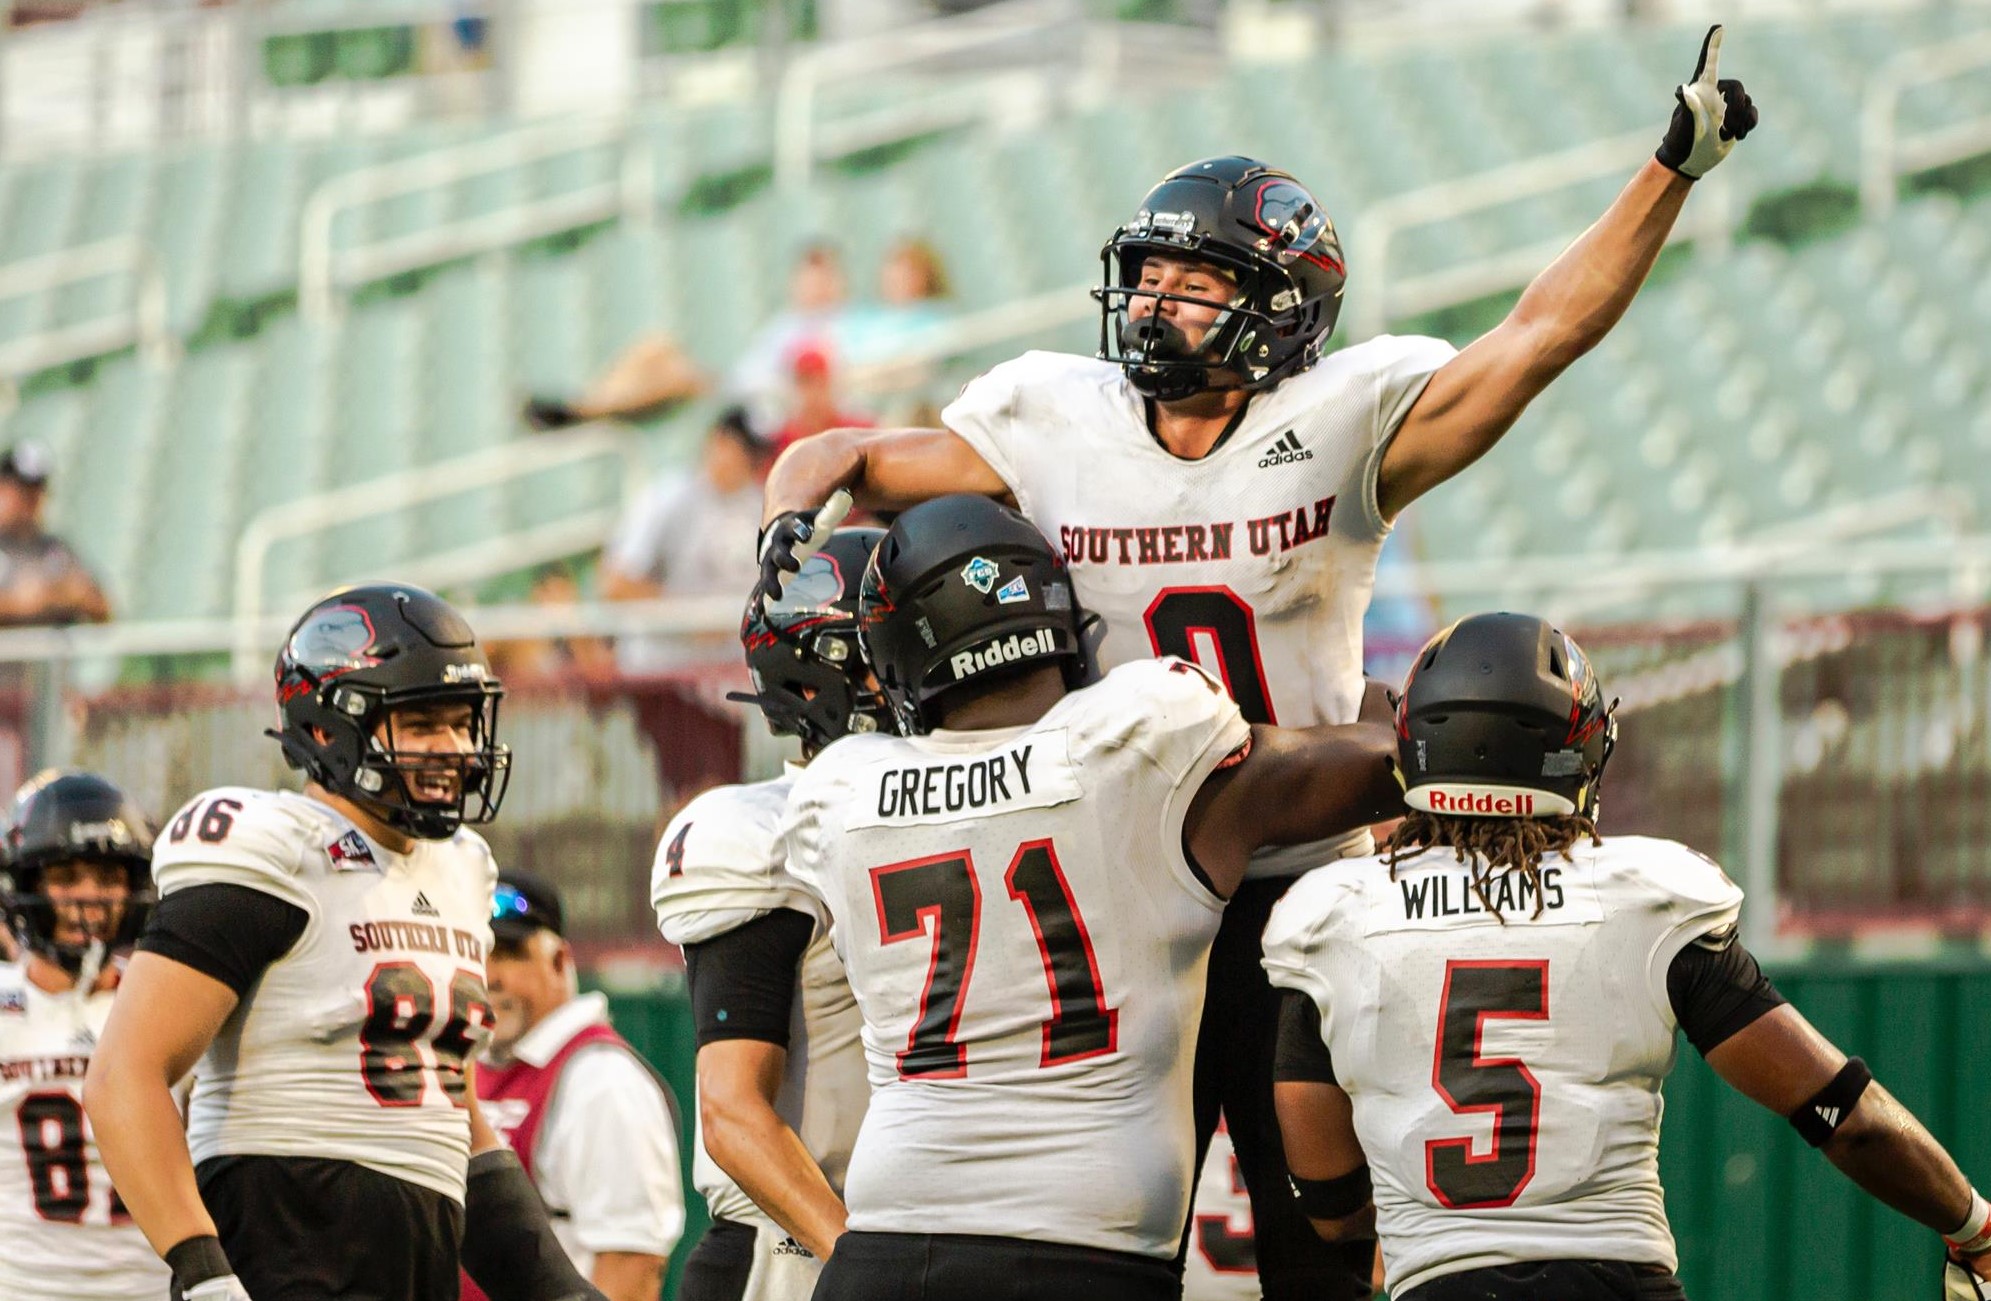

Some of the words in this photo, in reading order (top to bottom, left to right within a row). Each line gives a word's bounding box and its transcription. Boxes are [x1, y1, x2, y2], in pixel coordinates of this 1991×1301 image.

[1258, 448, 1314, 469] adidas
[1060, 522, 1234, 566] SOUTHERN
[1247, 495, 1337, 556] UTAH
[950, 628, 1056, 680] Riddell
[878, 745, 1033, 818] GREGORY
[1429, 790, 1533, 815] Riddell
[665, 820, 694, 879] 4
[1400, 868, 1564, 920] WILLIAMS
[350, 921, 450, 955] SOUTHERN
[869, 838, 1119, 1081] 71
[1425, 959, 1550, 1210] 5
